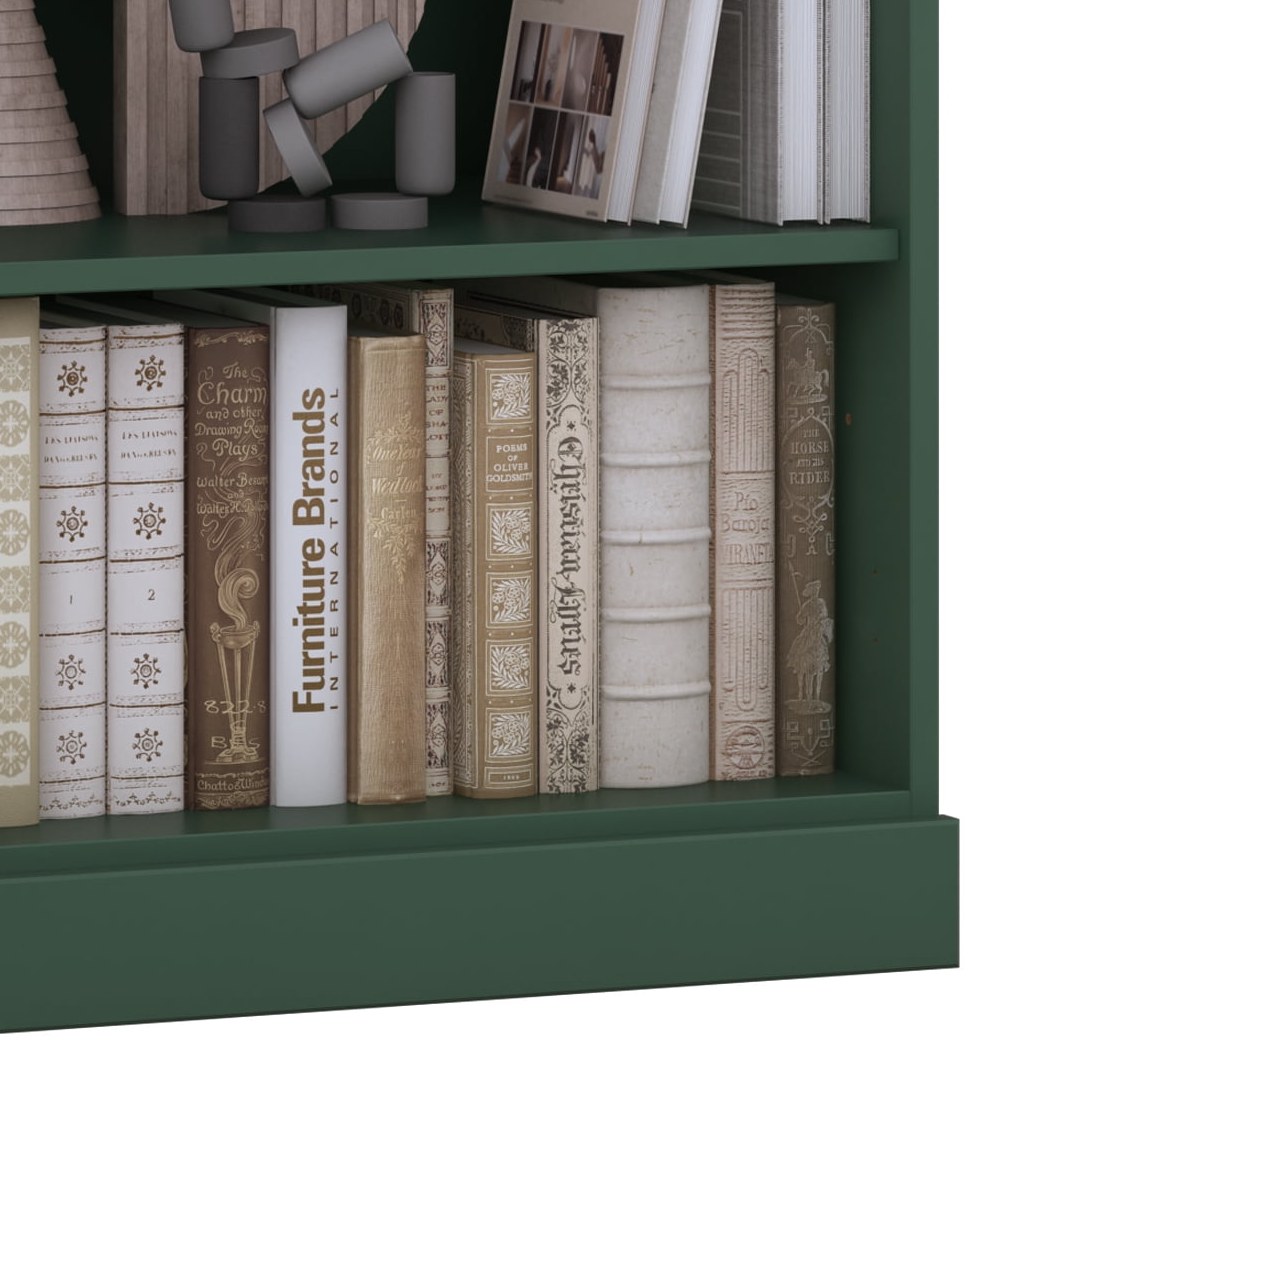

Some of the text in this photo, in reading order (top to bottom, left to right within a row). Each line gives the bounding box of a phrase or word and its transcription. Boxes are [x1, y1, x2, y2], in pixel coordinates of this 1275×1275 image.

[223, 361, 248, 379] The
[197, 382, 266, 405] Charm
[206, 408, 229, 421] and
[195, 422, 243, 439] Drawing
[212, 438, 258, 461] Plays
[496, 443, 527, 453] POEMS
[790, 440, 829, 455] HORSE
[493, 462, 529, 472] OLIVER
[197, 475, 235, 487] Walter
[789, 470, 830, 485] RIDER
[292, 388, 325, 713] Furniture Brands
[330, 388, 339, 710] INTERNATIONAL
[550, 436, 587, 676] Christian Lyrics
[147, 589, 156, 601] 2
